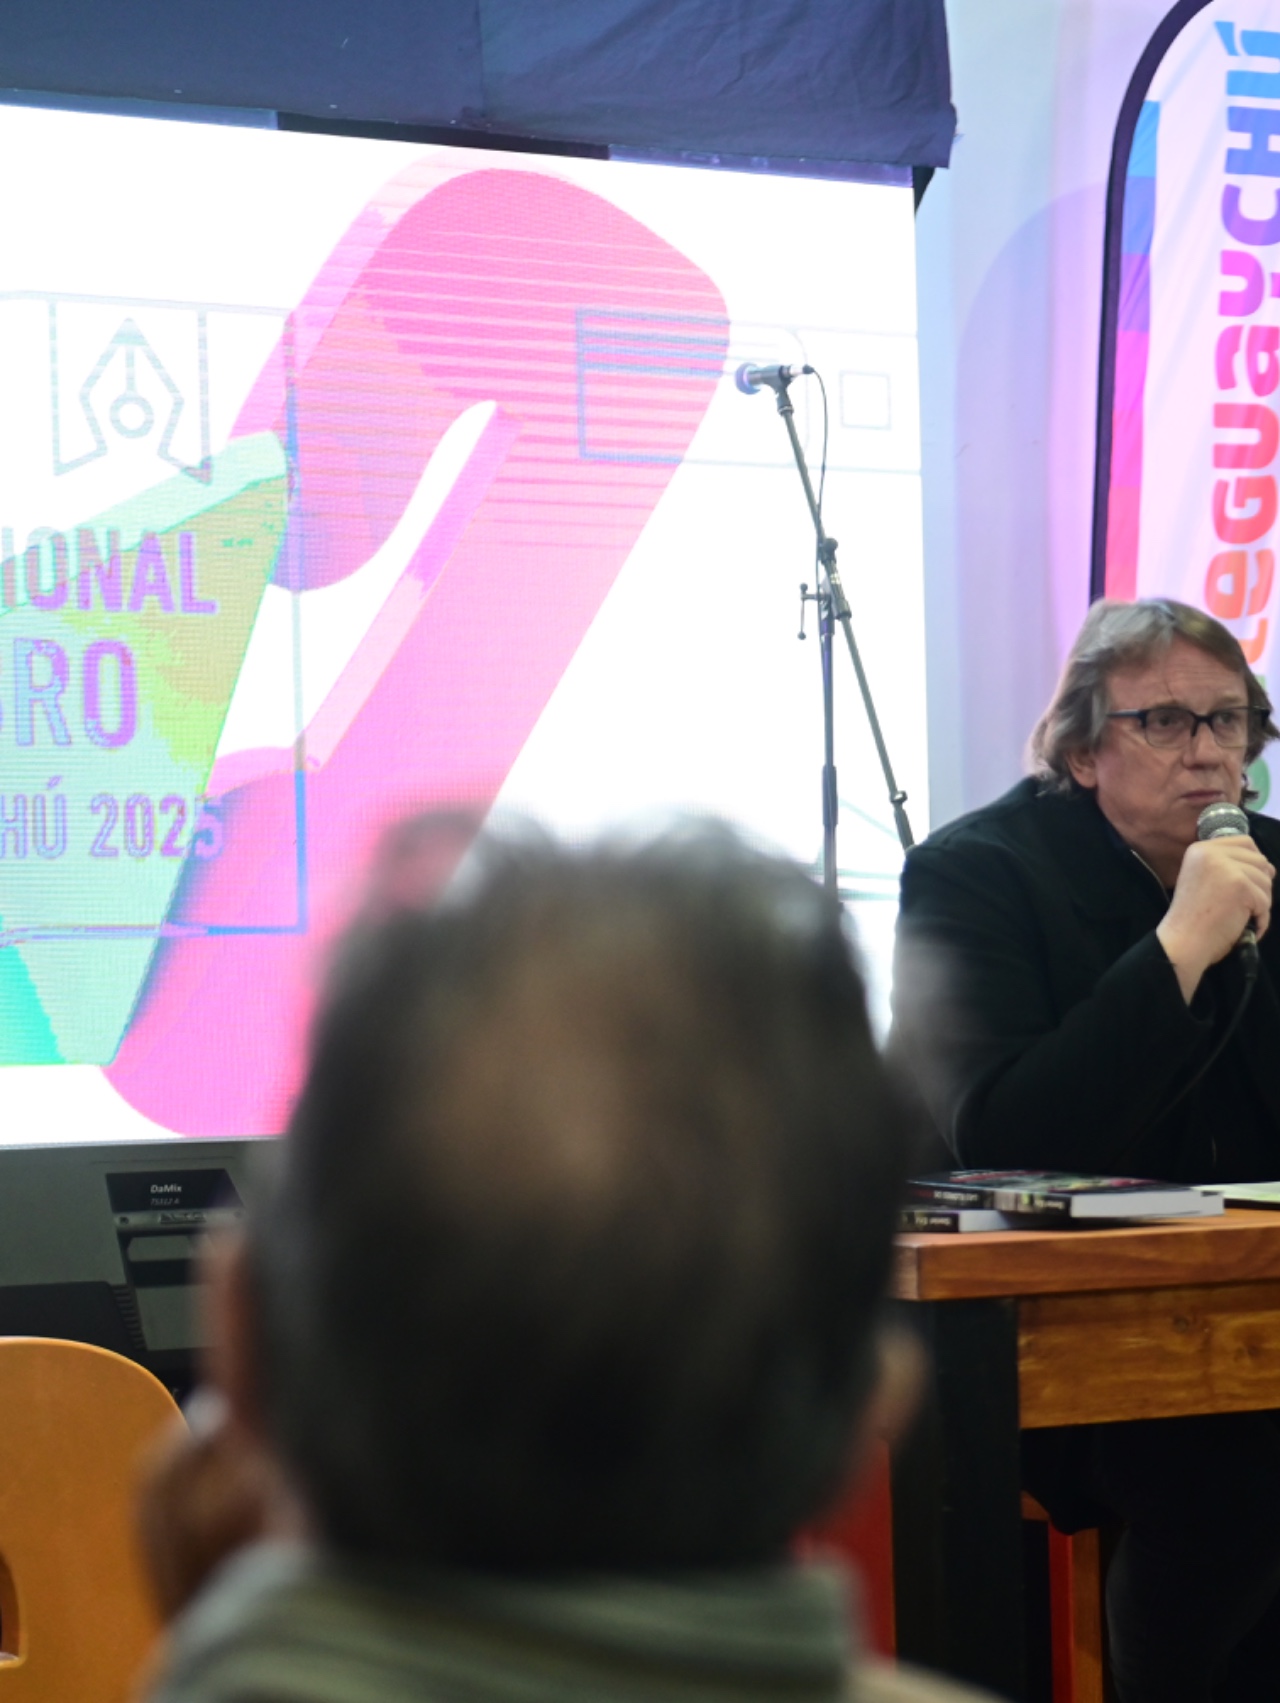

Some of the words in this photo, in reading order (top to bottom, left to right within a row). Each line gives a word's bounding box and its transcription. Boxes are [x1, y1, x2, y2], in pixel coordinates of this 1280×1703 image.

[0, 636, 139, 748] RO
[90, 793, 226, 861] 2025
[150, 1184, 182, 1194] DaMix
